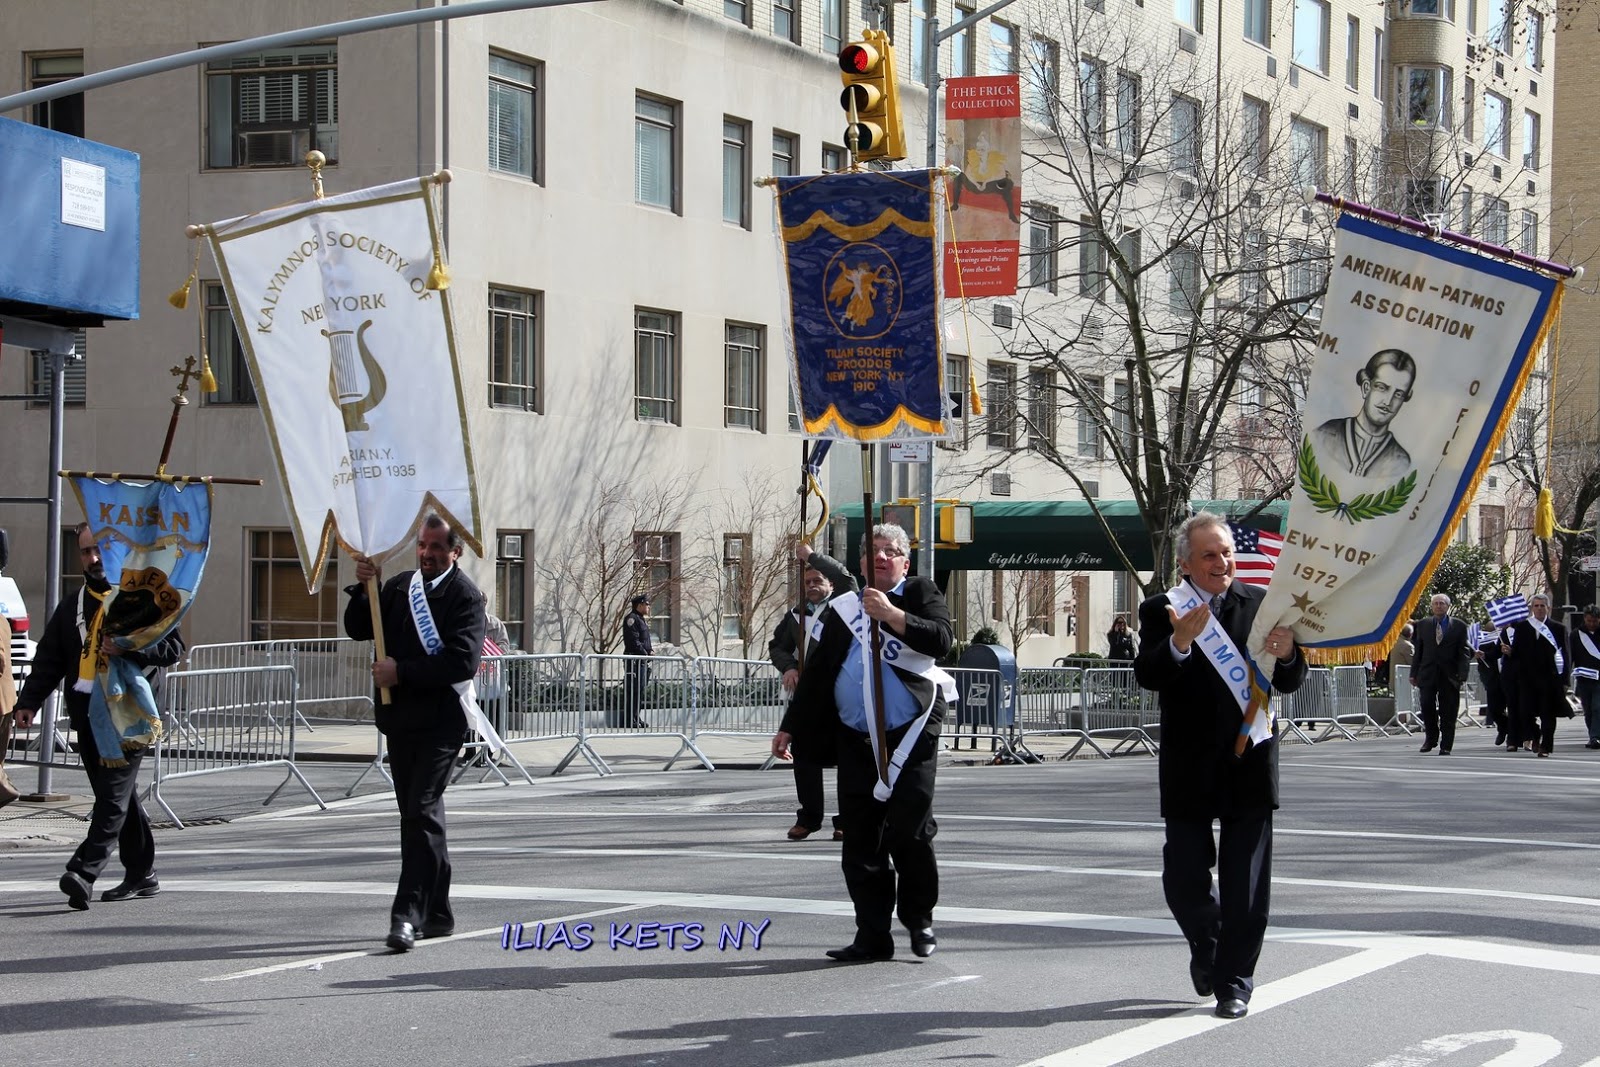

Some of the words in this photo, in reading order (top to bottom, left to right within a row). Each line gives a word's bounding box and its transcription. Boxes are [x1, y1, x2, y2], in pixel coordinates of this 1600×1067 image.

[951, 86, 977, 97] THE
[979, 85, 1014, 96] FRICK
[951, 99, 1015, 109] COLLECTION
[961, 266, 975, 275] from
[257, 234, 319, 334] KALYMNOS
[326, 230, 410, 272] SOCIETY
[410, 277, 432, 302] OF
[330, 293, 386, 312] YORK
[1350, 289, 1475, 341] ASSOCIATION
[856, 346, 904, 358] SOCIETY
[837, 358, 892, 370] PROODOS
[826, 371, 846, 382] NEW
[852, 369, 882, 380] YORK
[853, 381, 876, 392] 1910
[387, 464, 416, 477] 1935
[988, 552, 1022, 568] Eight
[1024, 552, 1073, 569] Seventy
[1074, 551, 1103, 565] Five
[1293, 562, 1338, 589] 1972
[1181, 597, 1251, 701] PTMOS
